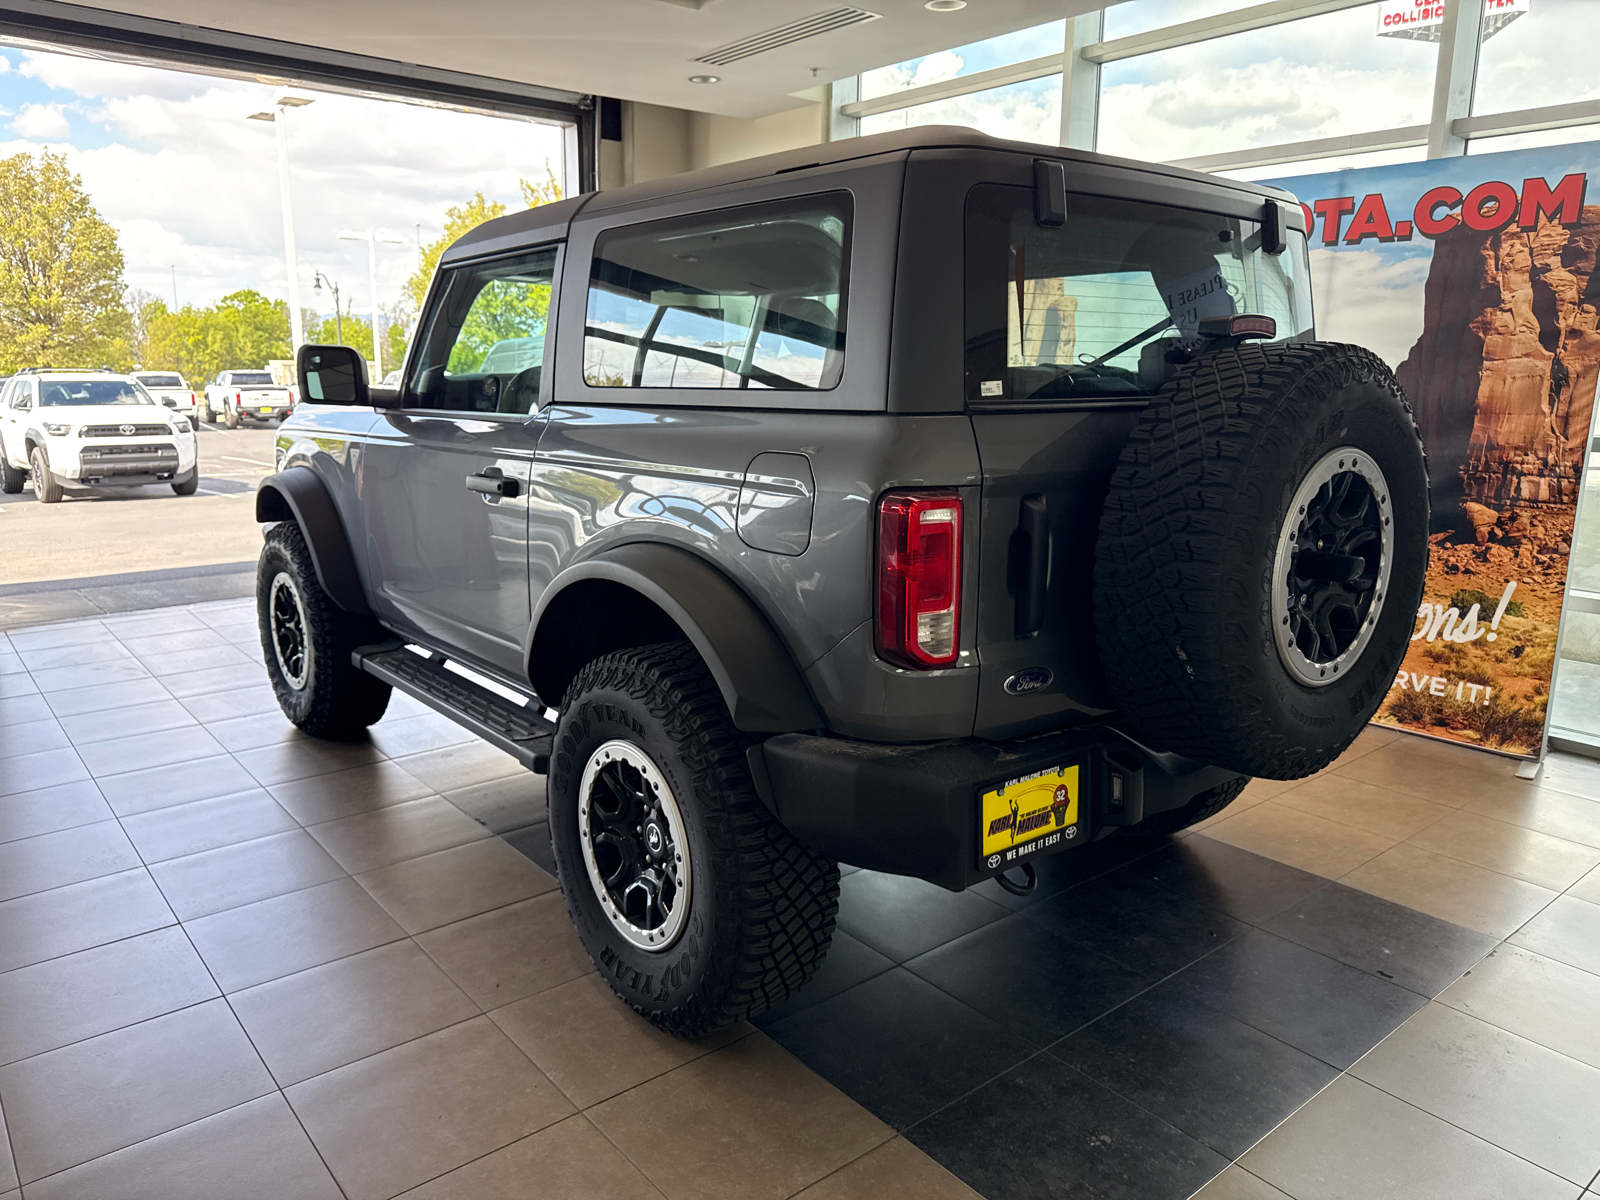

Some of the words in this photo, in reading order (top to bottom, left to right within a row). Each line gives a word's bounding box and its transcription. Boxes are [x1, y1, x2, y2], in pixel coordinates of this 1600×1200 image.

[1383, 6, 1444, 26] COLLISIO
[1393, 670, 1448, 697] RVE
[1456, 681, 1492, 706] IT!
[1004, 780, 1019, 788] KARL
[1020, 772, 1041, 783] MALONE
[1041, 765, 1060, 776] TOYOTA
[1056, 789, 1065, 802] 32
[987, 813, 1013, 837] KARL
[1016, 810, 1053, 836] MALONE
[1006, 849, 1016, 861] WE
[1018, 844, 1036, 857] MAKE
[1037, 840, 1044, 849] IT
[1045, 833, 1061, 847] EASY
